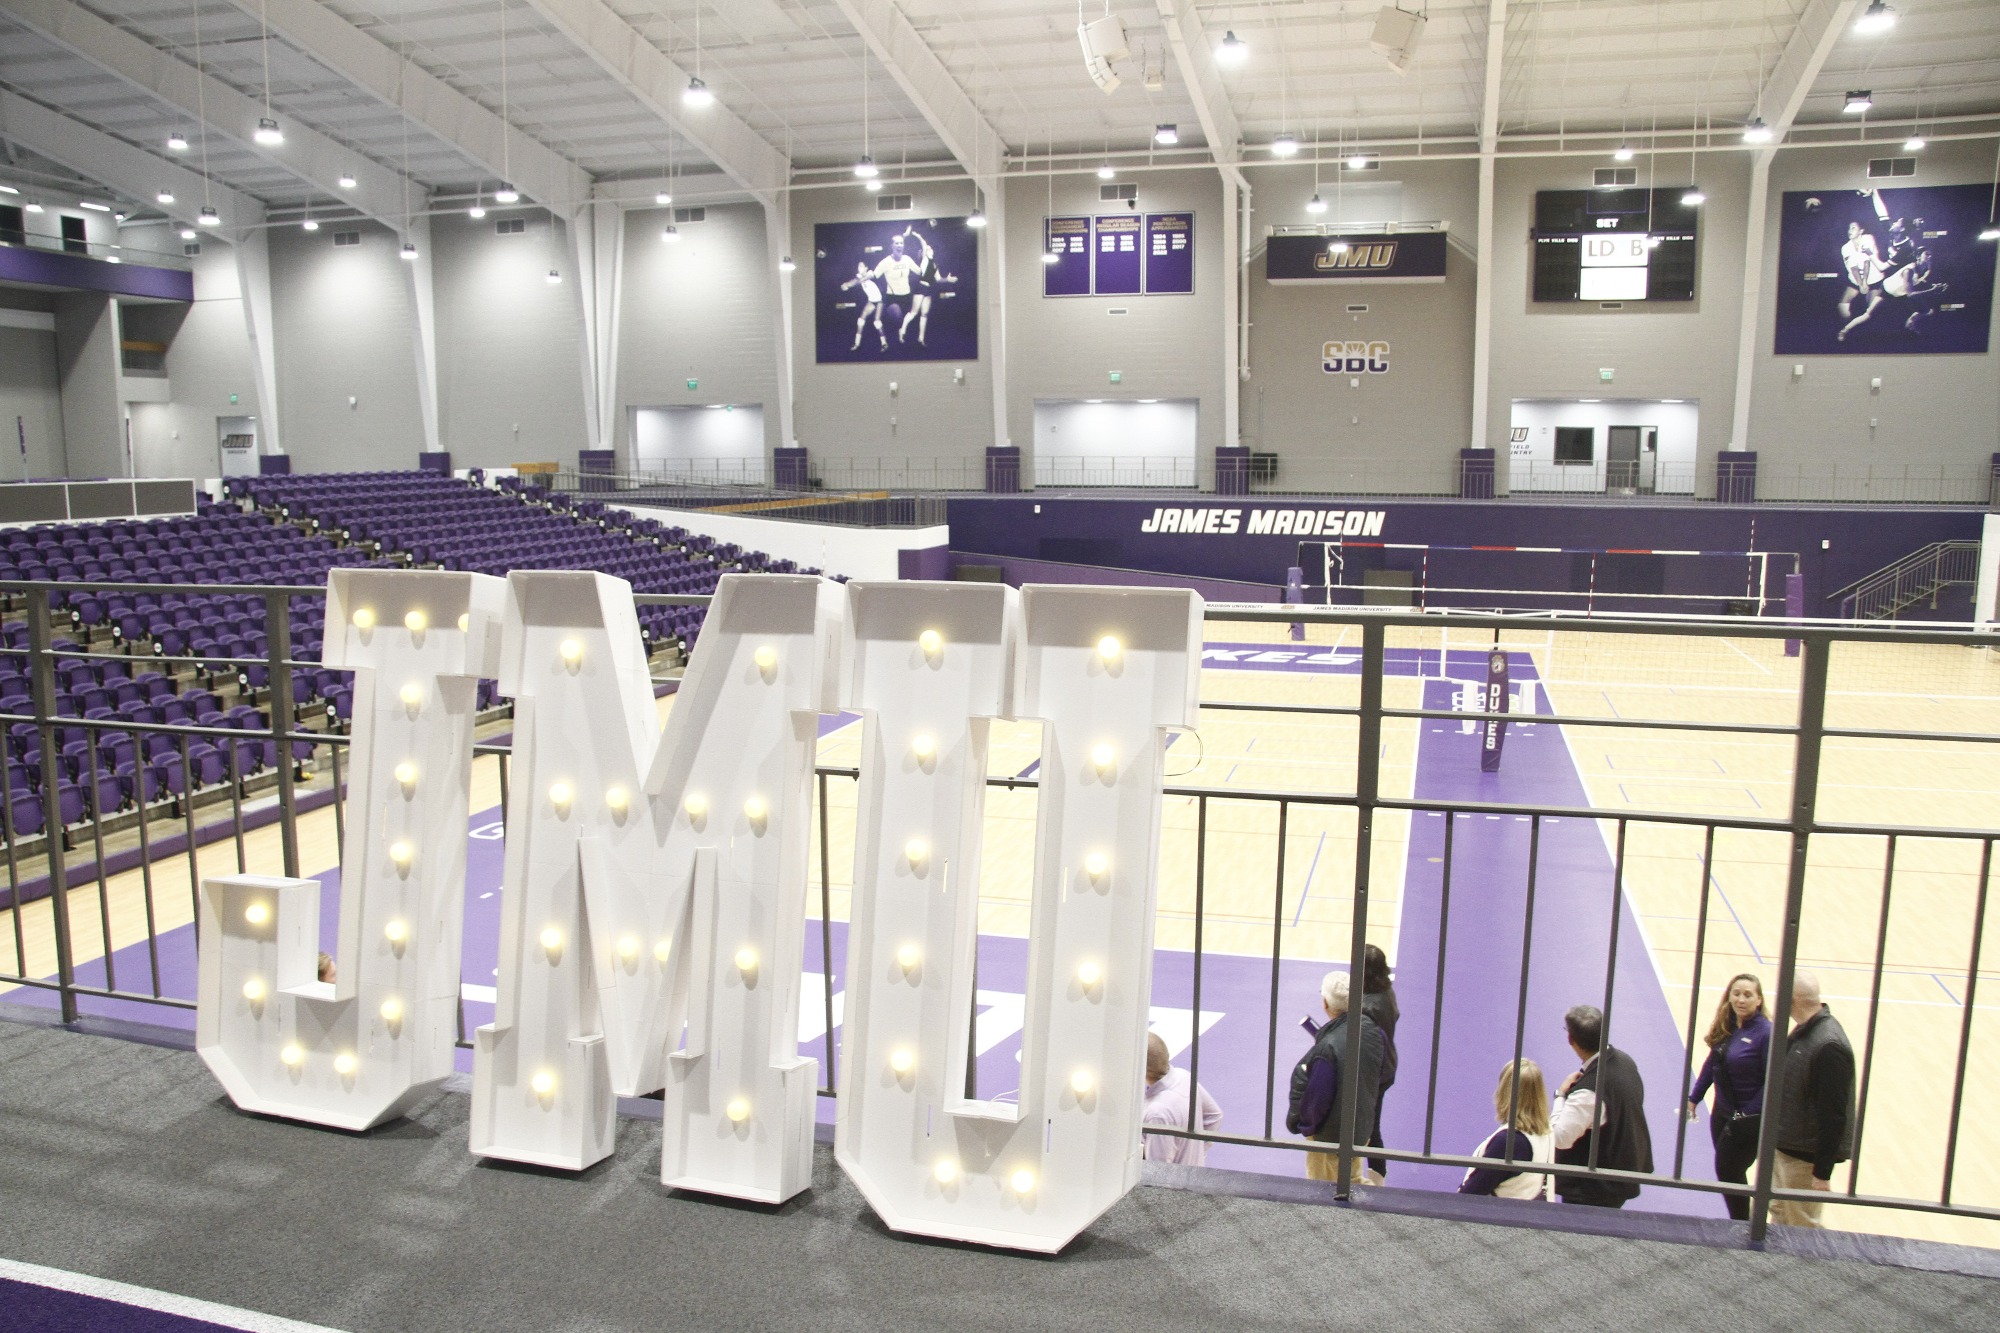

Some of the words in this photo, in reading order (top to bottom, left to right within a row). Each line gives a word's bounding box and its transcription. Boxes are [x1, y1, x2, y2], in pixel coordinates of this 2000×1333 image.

[1596, 218, 1619, 228] SET
[1315, 242, 1397, 270] JMU
[1322, 341, 1390, 374] SBC
[222, 434, 253, 448] JMU
[1141, 508, 1242, 534] JAMES
[1247, 510, 1386, 536] MADISON
[195, 567, 1203, 1255] JMU
